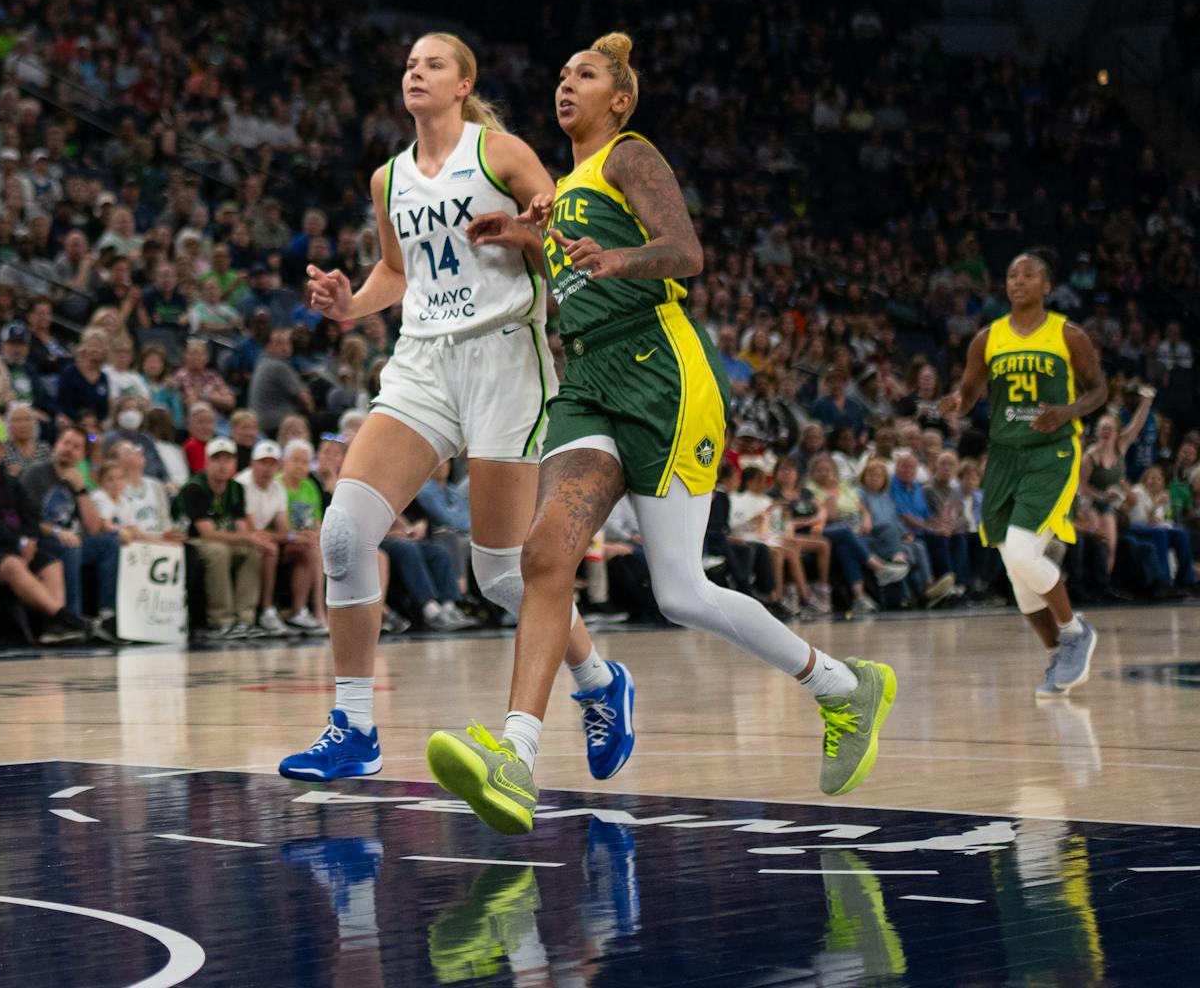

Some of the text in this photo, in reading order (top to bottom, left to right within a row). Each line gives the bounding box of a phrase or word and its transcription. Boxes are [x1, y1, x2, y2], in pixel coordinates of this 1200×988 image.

[397, 196, 474, 239] LYNX
[420, 236, 460, 280] 14
[428, 287, 472, 307] MAYO
[991, 353, 1055, 381] SEATTLE
[1006, 373, 1038, 402] 24
